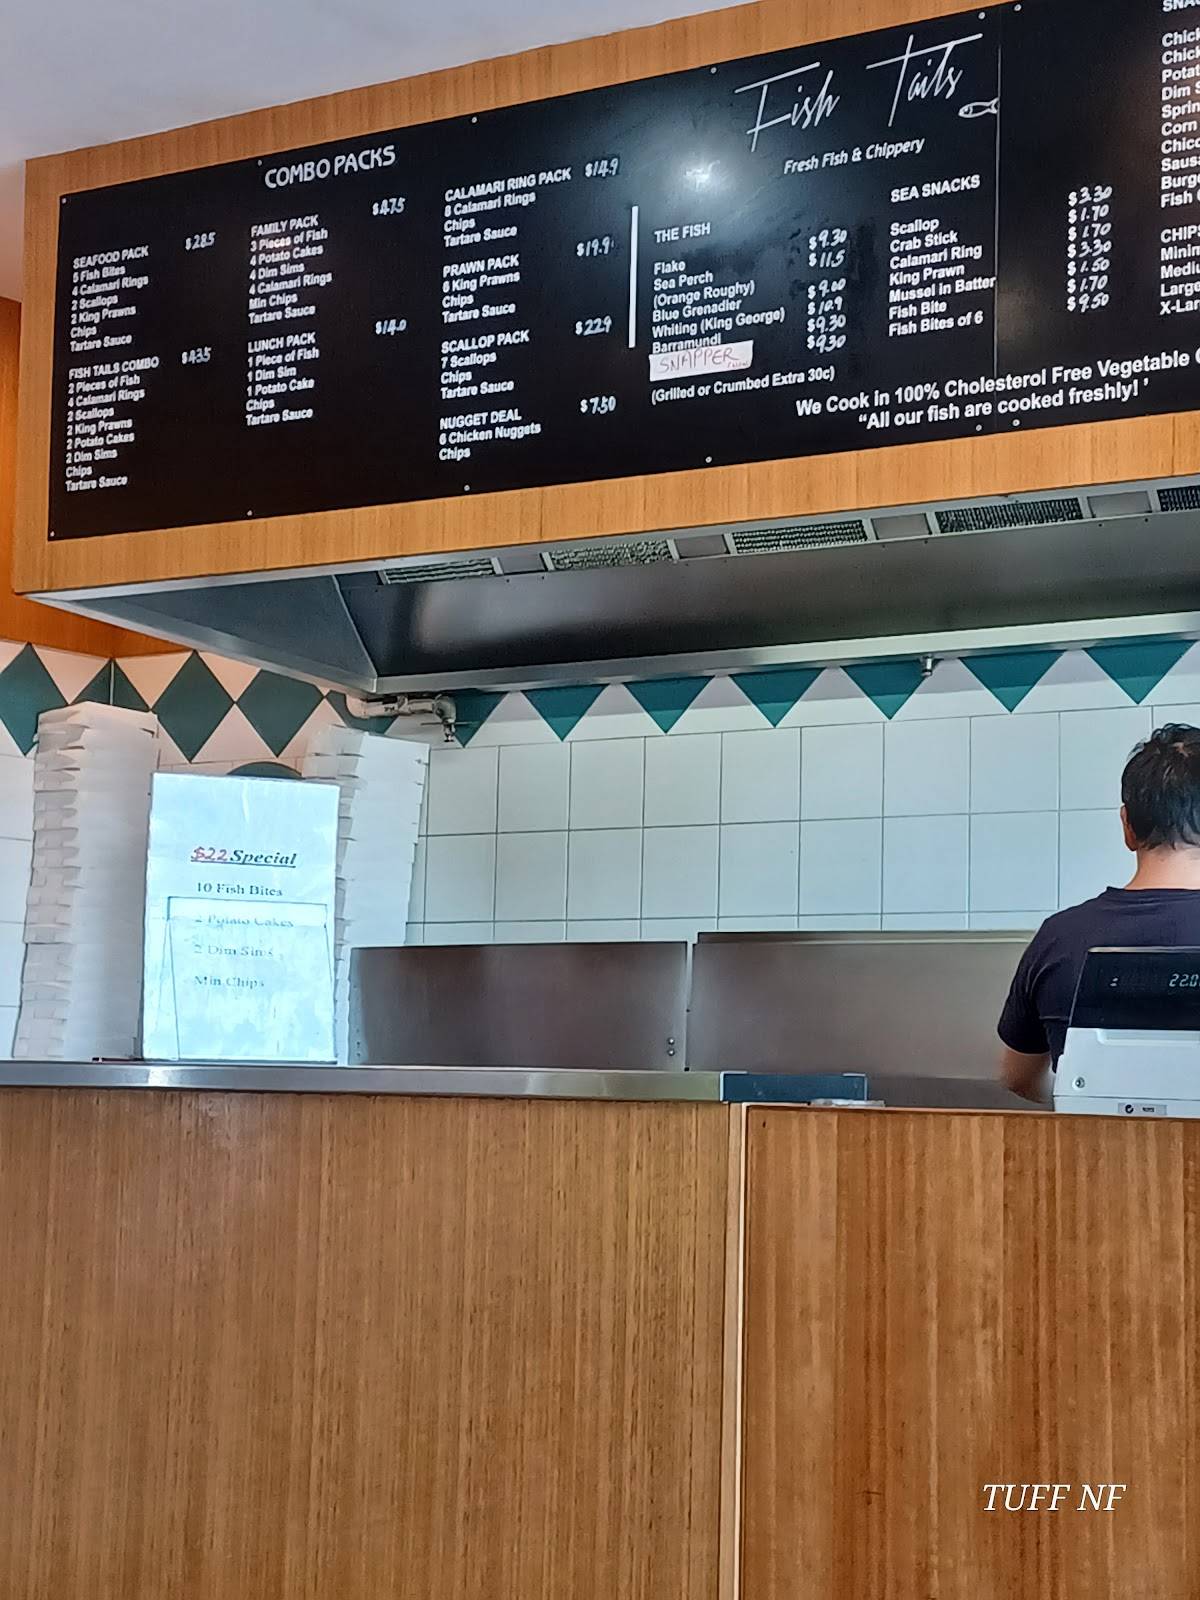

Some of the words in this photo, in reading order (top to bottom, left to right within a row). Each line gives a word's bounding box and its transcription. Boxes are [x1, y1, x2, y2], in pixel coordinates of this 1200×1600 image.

[735, 62, 840, 152] Fish
[865, 33, 983, 127] Tails
[1162, 85, 1190, 100] Dim
[1162, 121, 1197, 136] Corn
[784, 153, 818, 174] Fresh
[822, 148, 848, 167] Fish
[851, 149, 862, 162] &
[865, 137, 925, 160] Chippery
[265, 159, 330, 188] COMBO
[334, 145, 396, 176] PACKS
[445, 184, 505, 202] CALAMARI
[507, 175, 536, 191] RING
[538, 167, 571, 185] PACK
[890, 188, 919, 203] SEA
[922, 174, 981, 197] SNACKS
[454, 197, 501, 215] Calamari
[504, 192, 536, 207] Rings
[1161, 190, 1192, 208] Fish
[251, 220, 287, 237] FAMILY
[290, 214, 319, 231] PACK
[444, 218, 475, 232] Chips
[483, 226, 517, 241] Sauce
[655, 227, 679, 243] THE
[682, 222, 711, 239] FISH
[890, 218, 939, 237] Scallop
[259, 236, 291, 250] Pieces
[306, 229, 328, 241] Fish
[890, 237, 921, 253] Crab
[924, 230, 958, 247] Stick
[73, 251, 120, 269] SEAFOOD
[122, 246, 148, 260] PACK
[259, 251, 290, 265] Potato
[293, 244, 323, 258] Cakes
[890, 250, 948, 270] Calamari
[951, 244, 982, 260] Ring
[80, 268, 100, 281] Fish
[258, 266, 278, 278] Dim
[280, 262, 304, 275] Sims
[443, 260, 485, 278] PRAWN
[487, 254, 519, 271] PACK
[654, 260, 686, 275] Flake
[889, 271, 920, 287] King
[923, 264, 965, 281] Prawn
[122, 276, 148, 289] Rings
[257, 278, 301, 294] Calamari
[303, 272, 332, 286] Rings
[452, 277, 477, 292] King
[479, 271, 520, 287] Prawns
[654, 277, 676, 292] Sea
[679, 271, 714, 287] Perch
[889, 284, 935, 303] Mussel
[939, 281, 951, 295] in
[955, 275, 996, 293] Batter
[269, 293, 297, 306] Chips
[442, 293, 473, 308] Chips
[653, 289, 701, 309] (Orange
[704, 279, 755, 300] Roughy)
[79, 311, 100, 323] King
[102, 306, 136, 320] Prawns
[284, 305, 315, 319] Sauce
[482, 302, 516, 317] Sauce
[653, 307, 679, 322] Blue
[683, 299, 742, 318] Grenadier
[889, 303, 917, 320] Fish
[920, 300, 947, 315] Bite
[70, 326, 96, 338] Chips
[652, 321, 697, 338] Whiting
[700, 317, 733, 334] (King
[736, 307, 785, 326] George)
[889, 319, 917, 337] Fish
[920, 315, 954, 333] Bites
[974, 310, 983, 325] 6
[103, 335, 132, 347] Sauce
[248, 337, 284, 353] LUNCH
[286, 331, 315, 346] PACK
[441, 335, 495, 354] SCALLOP
[497, 329, 530, 346] PACK
[69, 367, 91, 379] FISH
[93, 363, 119, 375] TAILS
[122, 356, 159, 372] COMBO
[256, 354, 282, 367] Piece
[297, 347, 319, 360] Fish
[441, 357, 447, 369] 7
[450, 351, 496, 368] Scallops
[659, 347, 740, 374] SNAPPER
[76, 380, 106, 393] Pieces
[120, 374, 140, 386] Fish
[256, 369, 274, 381] Dim
[277, 366, 296, 378] Sim
[441, 370, 472, 385] Chips
[796, 399, 822, 416] We
[826, 392, 869, 413] Cook
[874, 390, 889, 406] in
[895, 382, 940, 404] 100%
[945, 368, 1046, 397] Cholesterol
[1052, 366, 1092, 384] Free
[1097, 350, 1190, 378] Vegetable
[255, 382, 287, 396] Potato
[289, 377, 314, 391] Cake
[480, 380, 514, 395] Sauce
[652, 385, 694, 405] (Grilled
[697, 384, 710, 396] or
[714, 374, 769, 395] Crumbed
[772, 370, 805, 386] Extra
[808, 366, 835, 382] 30c)
[246, 399, 275, 412] Chips
[282, 408, 313, 421] Sauce
[894, 409, 924, 426] our
[927, 403, 960, 422] fish
[964, 401, 992, 417] are
[997, 389, 1063, 414] cooked
[440, 413, 489, 430] NUGGET
[490, 408, 522, 423] DEAL
[449, 428, 493, 444] Chicken
[495, 422, 542, 440] Nuggets
[439, 447, 471, 461] Chips
[191, 846, 229, 862] $22
[230, 849, 297, 868] Special
[197, 882, 212, 892] 10
[217, 883, 245, 895] Fish
[250, 886, 283, 896] Bites
